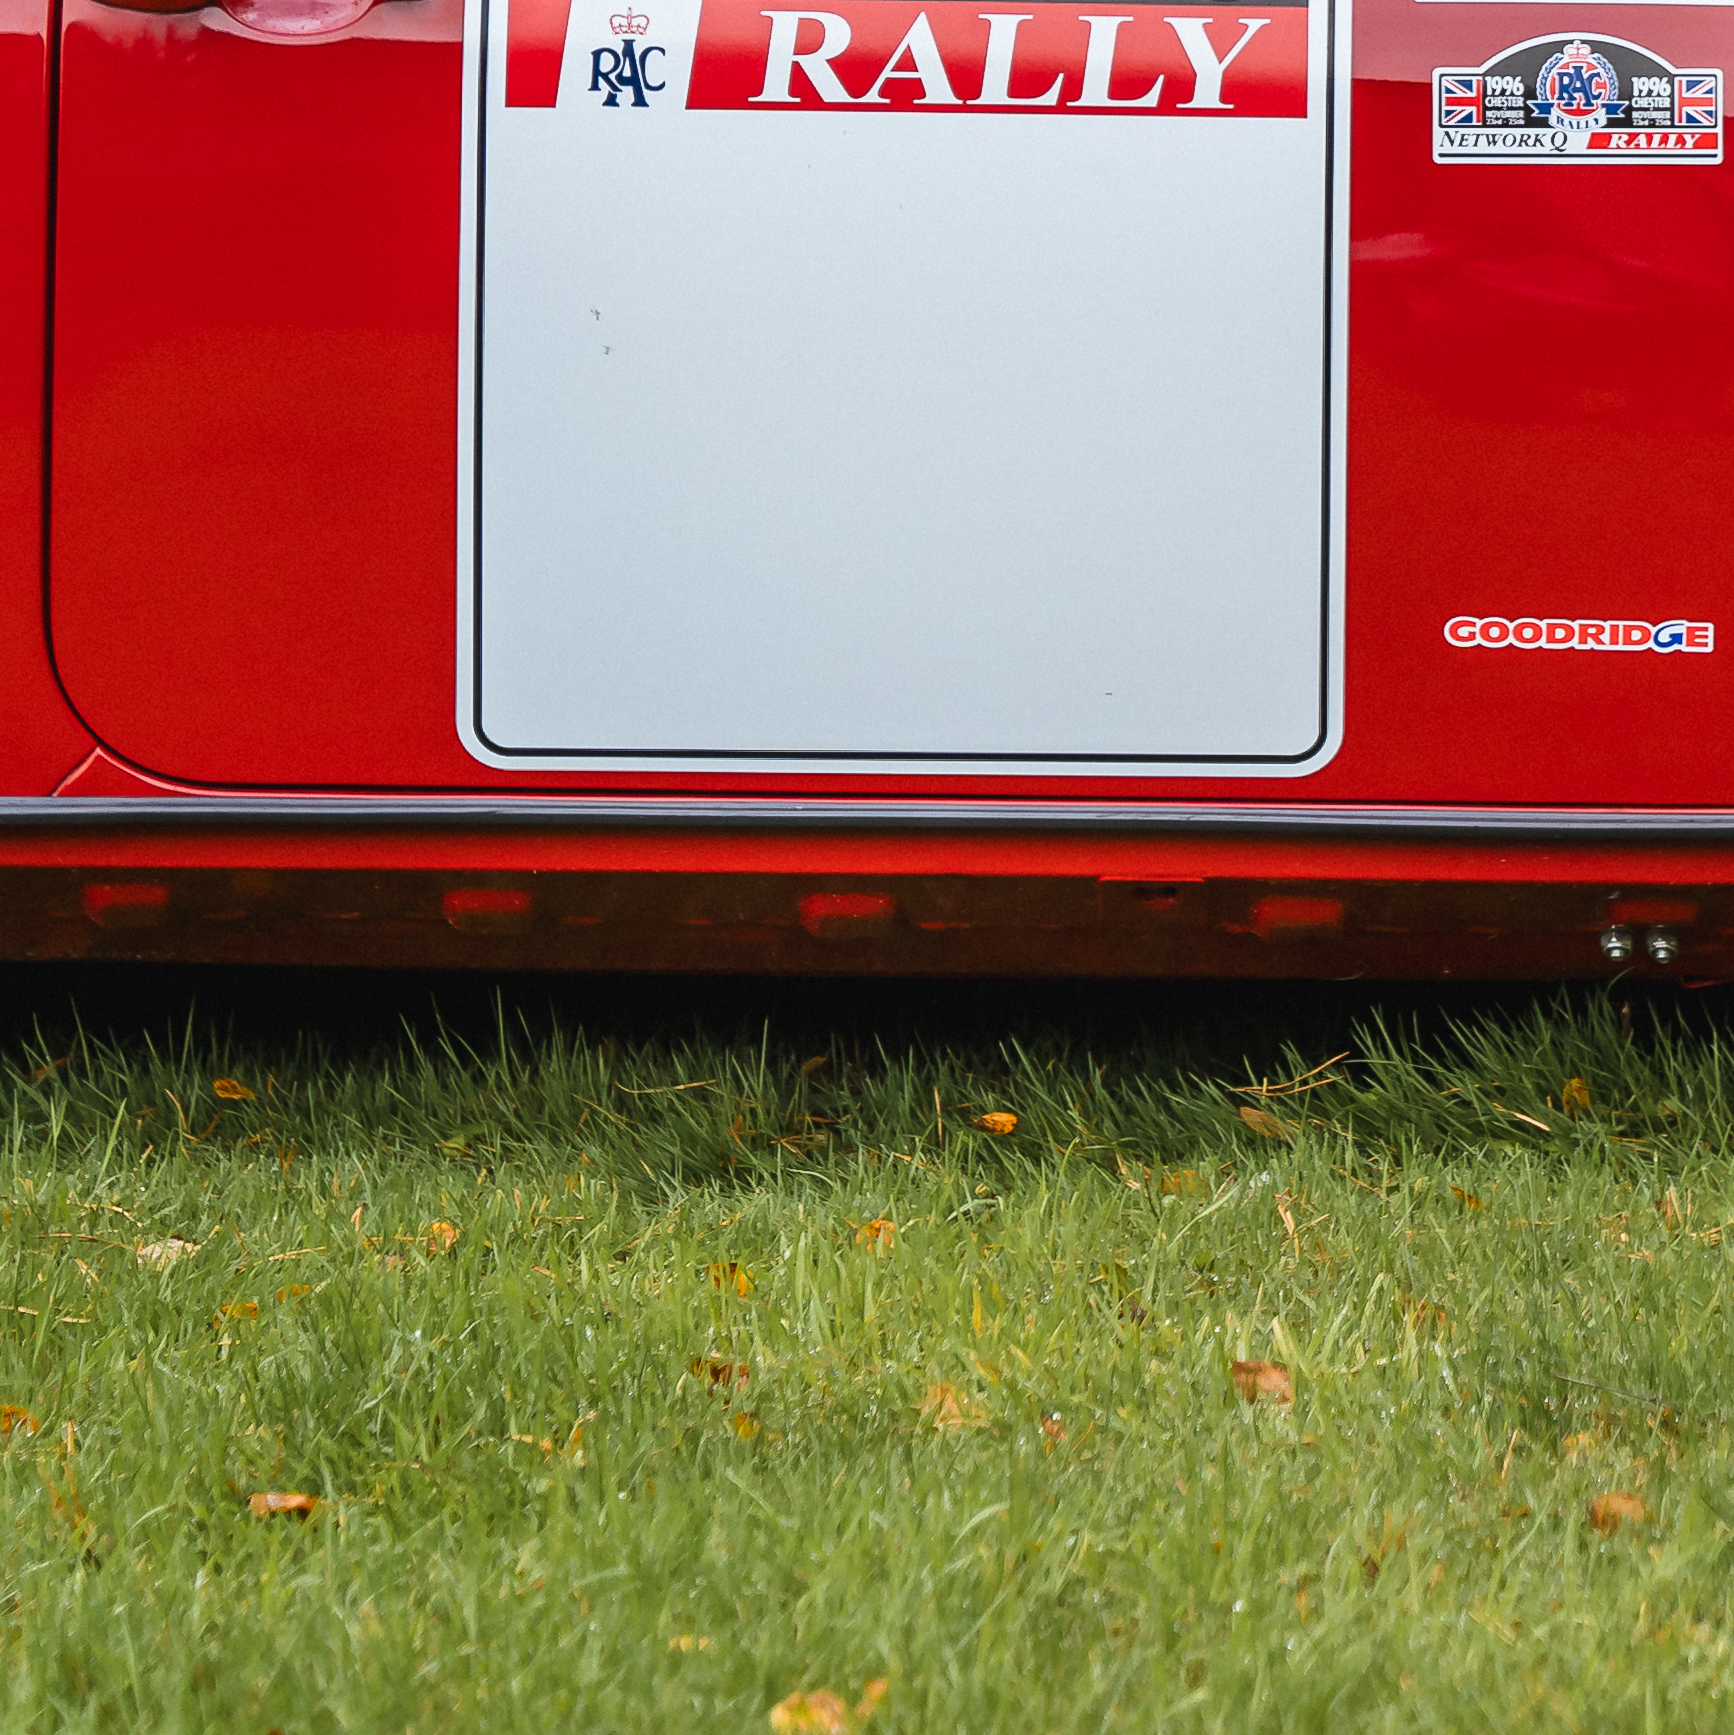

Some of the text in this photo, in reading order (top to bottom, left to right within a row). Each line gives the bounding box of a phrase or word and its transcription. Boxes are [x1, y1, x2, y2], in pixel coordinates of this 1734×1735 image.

[747, 9, 1273, 111] RALLY
[587, 38, 666, 108] RAC
[1484, 75, 1525, 96] 1996
[1556, 65, 1602, 107] RAC
[1631, 76, 1671, 97] 1996
[1484, 96, 1525, 108] CHESTER
[1631, 96, 1671, 108] CHESTER
[1556, 116, 1600, 130] RALLY
[1439, 130, 1547, 148] NETWORK
[1607, 133, 1702, 149] RALLY
[1448, 620, 1710, 648] GOODRIDGE
